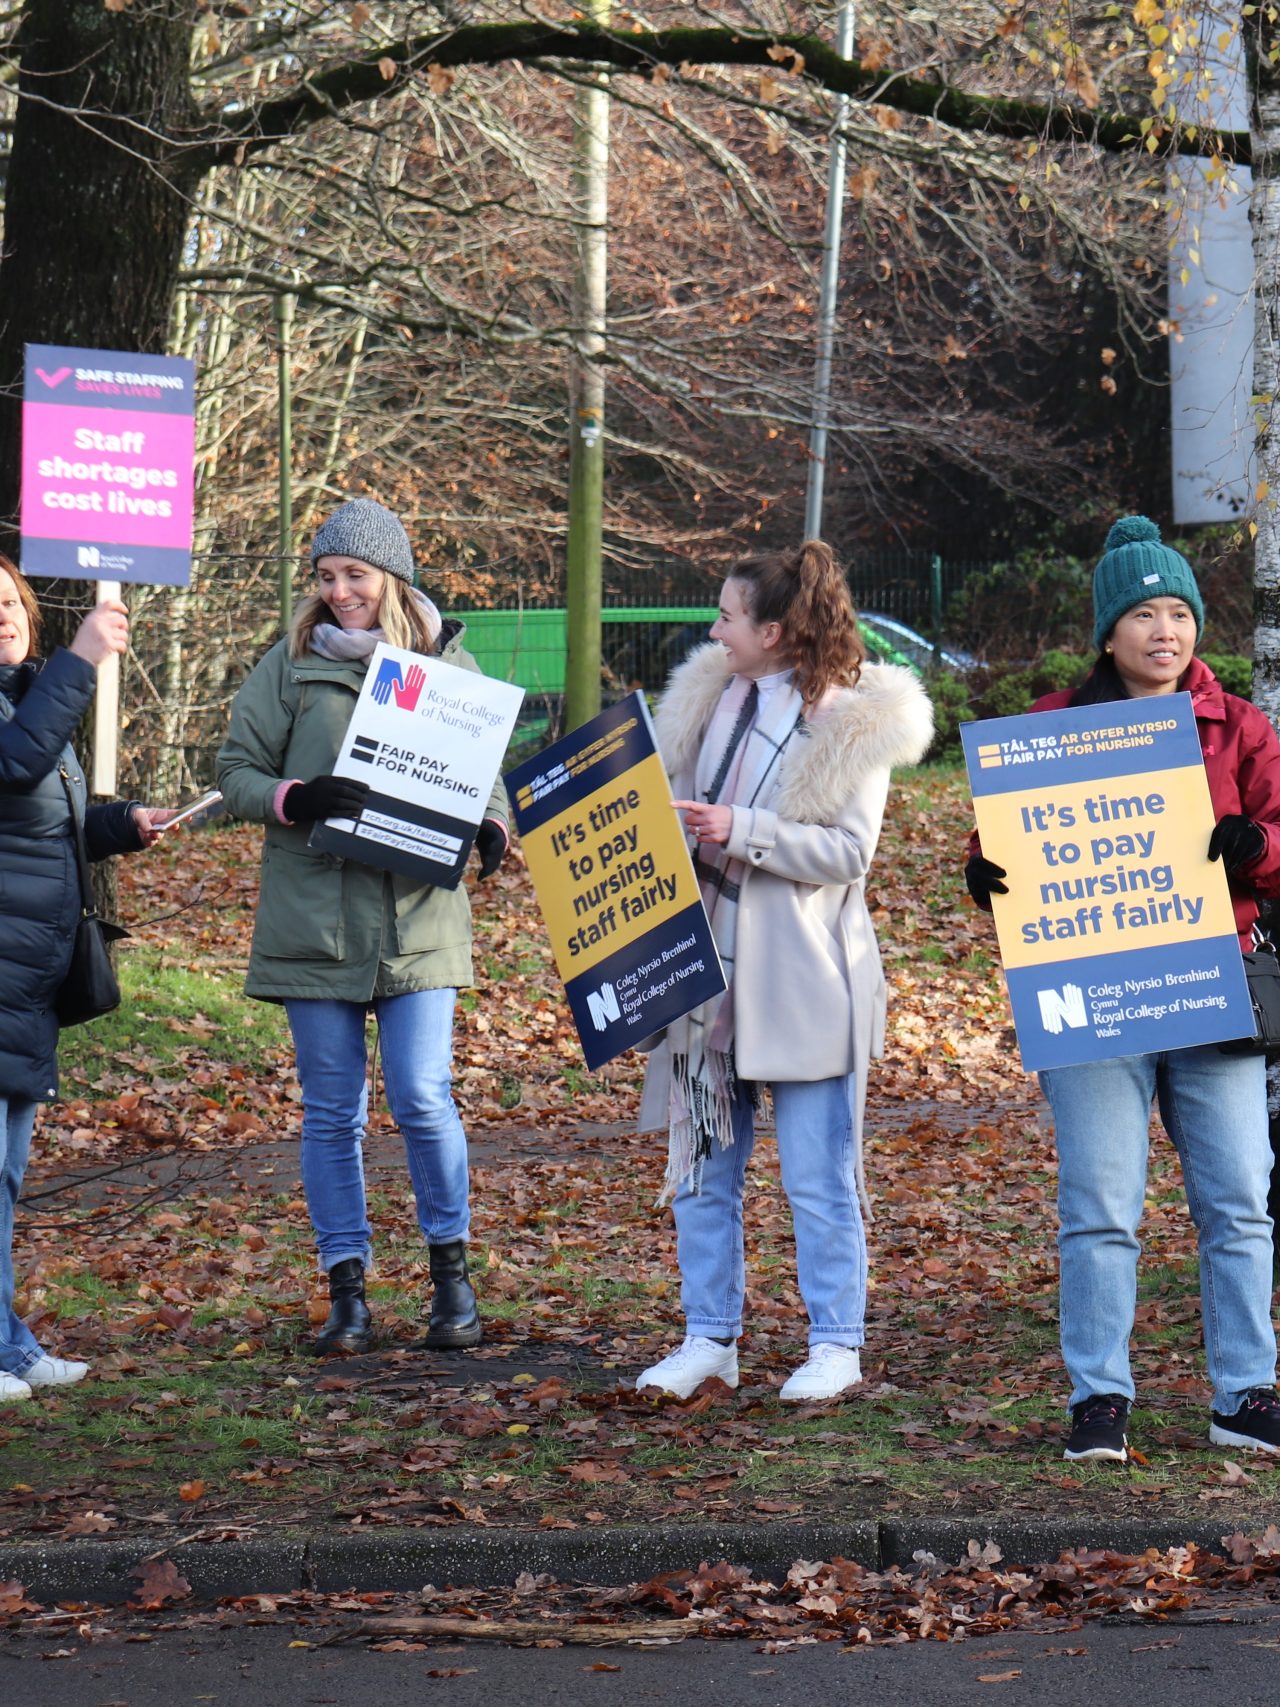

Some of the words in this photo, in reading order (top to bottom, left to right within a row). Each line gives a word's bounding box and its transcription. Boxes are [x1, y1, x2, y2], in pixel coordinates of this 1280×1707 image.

[75, 368, 114, 384] SAFE
[114, 371, 184, 390] STAFFING
[75, 380, 120, 396] SAVES
[74, 428, 145, 454] Staff
[38, 456, 178, 490] shortages
[42, 491, 103, 512] cost
[108, 490, 172, 518] lives
[422, 706, 434, 717] of
[437, 711, 482, 738] Nursing
[427, 690, 460, 710] Royal
[462, 702, 504, 726] College
[1001, 739, 1028, 754] TÂL
[1030, 736, 1056, 750] TEG
[1060, 732, 1078, 746] AR
[1081, 726, 1125, 742] GYFER
[1128, 720, 1177, 738] NYRSIO
[1003, 750, 1035, 766] FAIR
[1037, 747, 1063, 762] PAY
[1066, 743, 1094, 756] FOR
[1096, 735, 1154, 752] NURSING
[380, 744, 415, 762] FAIR
[420, 756, 449, 773] PAY
[376, 756, 408, 774] FOR
[410, 768, 479, 798] NURSING
[533, 782, 552, 802] FAIR
[552, 771, 570, 788] PAY
[550, 821, 586, 857] It’s
[588, 788, 640, 834] time
[1020, 803, 1076, 832] It’s
[1084, 792, 1165, 824] time
[361, 828, 452, 862] #FairPayForNursing
[366, 814, 448, 845] rcn.org.uk/fairpay
[569, 852, 594, 881] to
[598, 824, 638, 862] pay
[1042, 841, 1080, 866] to
[1091, 830, 1155, 865] pay
[572, 851, 656, 916] nursing
[1040, 864, 1174, 904] nursing
[567, 908, 617, 957] staff
[620, 872, 677, 920] fairly
[1022, 905, 1102, 944] staff
[1112, 894, 1204, 930] fairly
[616, 973, 638, 990] Coleg
[638, 958, 661, 978] Nyrsio
[662, 932, 696, 962] Brenhinol
[620, 987, 637, 1002] Cymru
[622, 994, 642, 1014] Royal
[642, 981, 668, 1002] College
[668, 972, 676, 986] of
[676, 960, 704, 982] Nursing
[1088, 982, 1123, 998] Coleg
[1124, 977, 1162, 994] Nyrsio
[1165, 966, 1220, 986] Brenhinol
[627, 1012, 642, 1026] Wales
[1091, 998, 1118, 1012] Cymru
[1092, 1008, 1124, 1026] Royal
[1126, 1002, 1166, 1020] College
[1168, 1000, 1180, 1012] of
[1182, 994, 1228, 1011] Nursing
[1096, 1026, 1121, 1038] Wales
